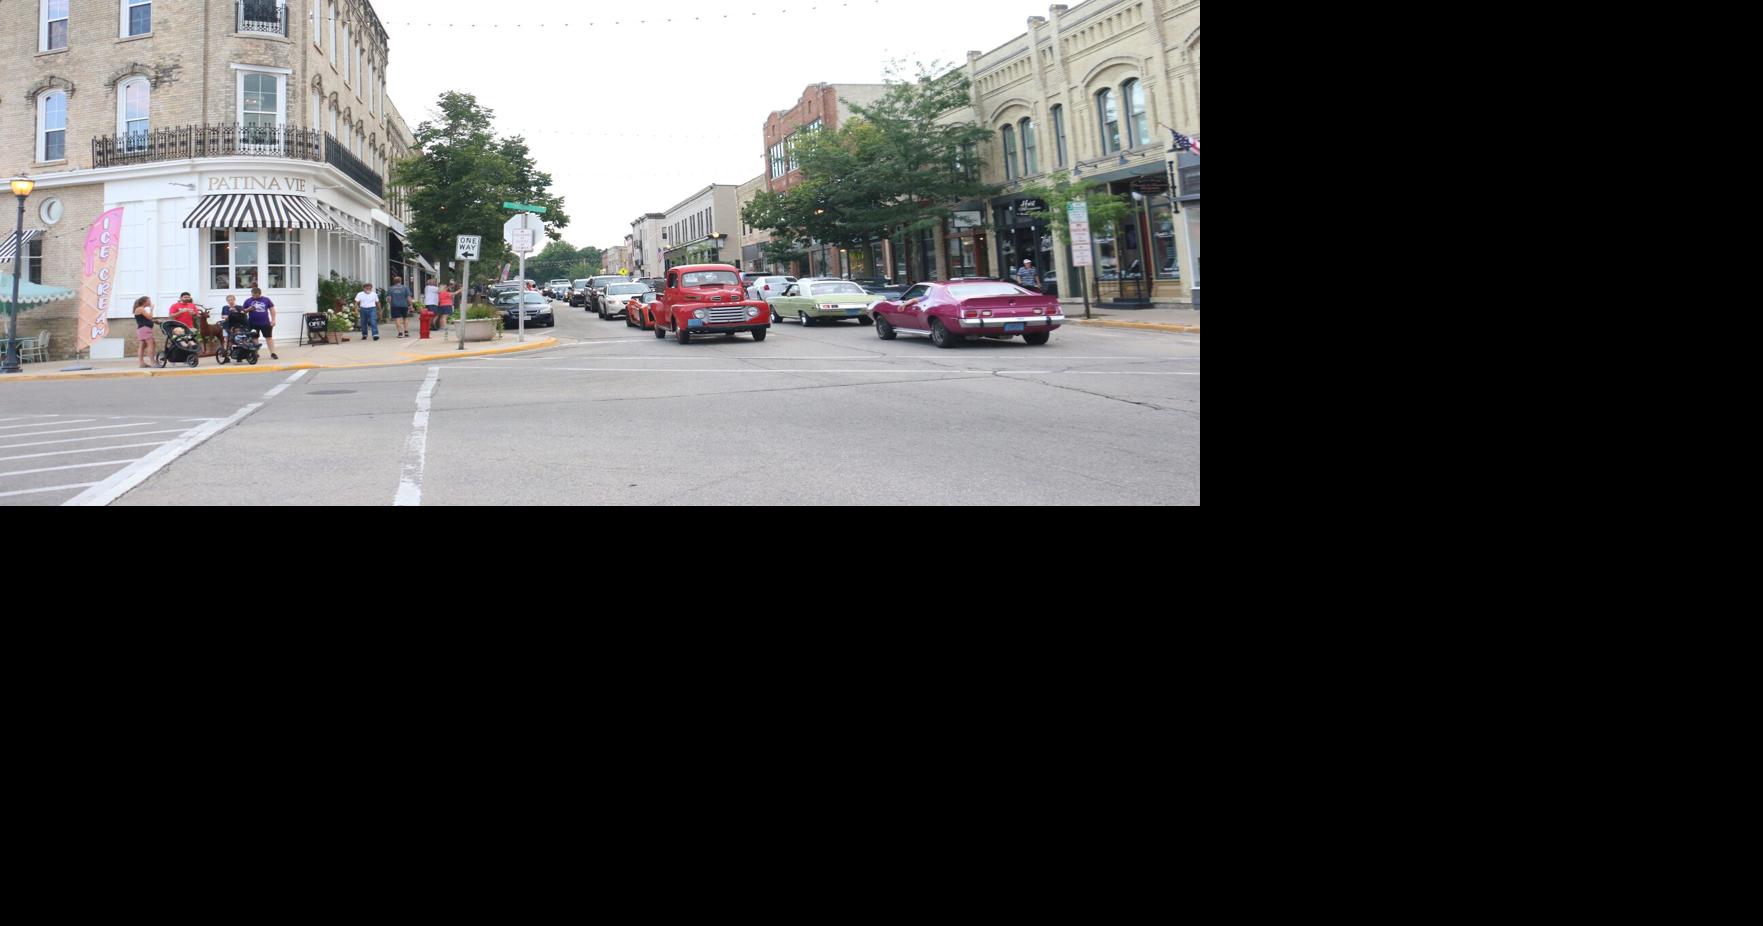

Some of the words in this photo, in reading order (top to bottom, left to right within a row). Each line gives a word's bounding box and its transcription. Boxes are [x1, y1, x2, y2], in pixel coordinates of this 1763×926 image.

[207, 176, 281, 191] PATINA
[284, 176, 306, 192] VIE
[99, 217, 111, 259] ICE
[91, 268, 110, 340] CREAM
